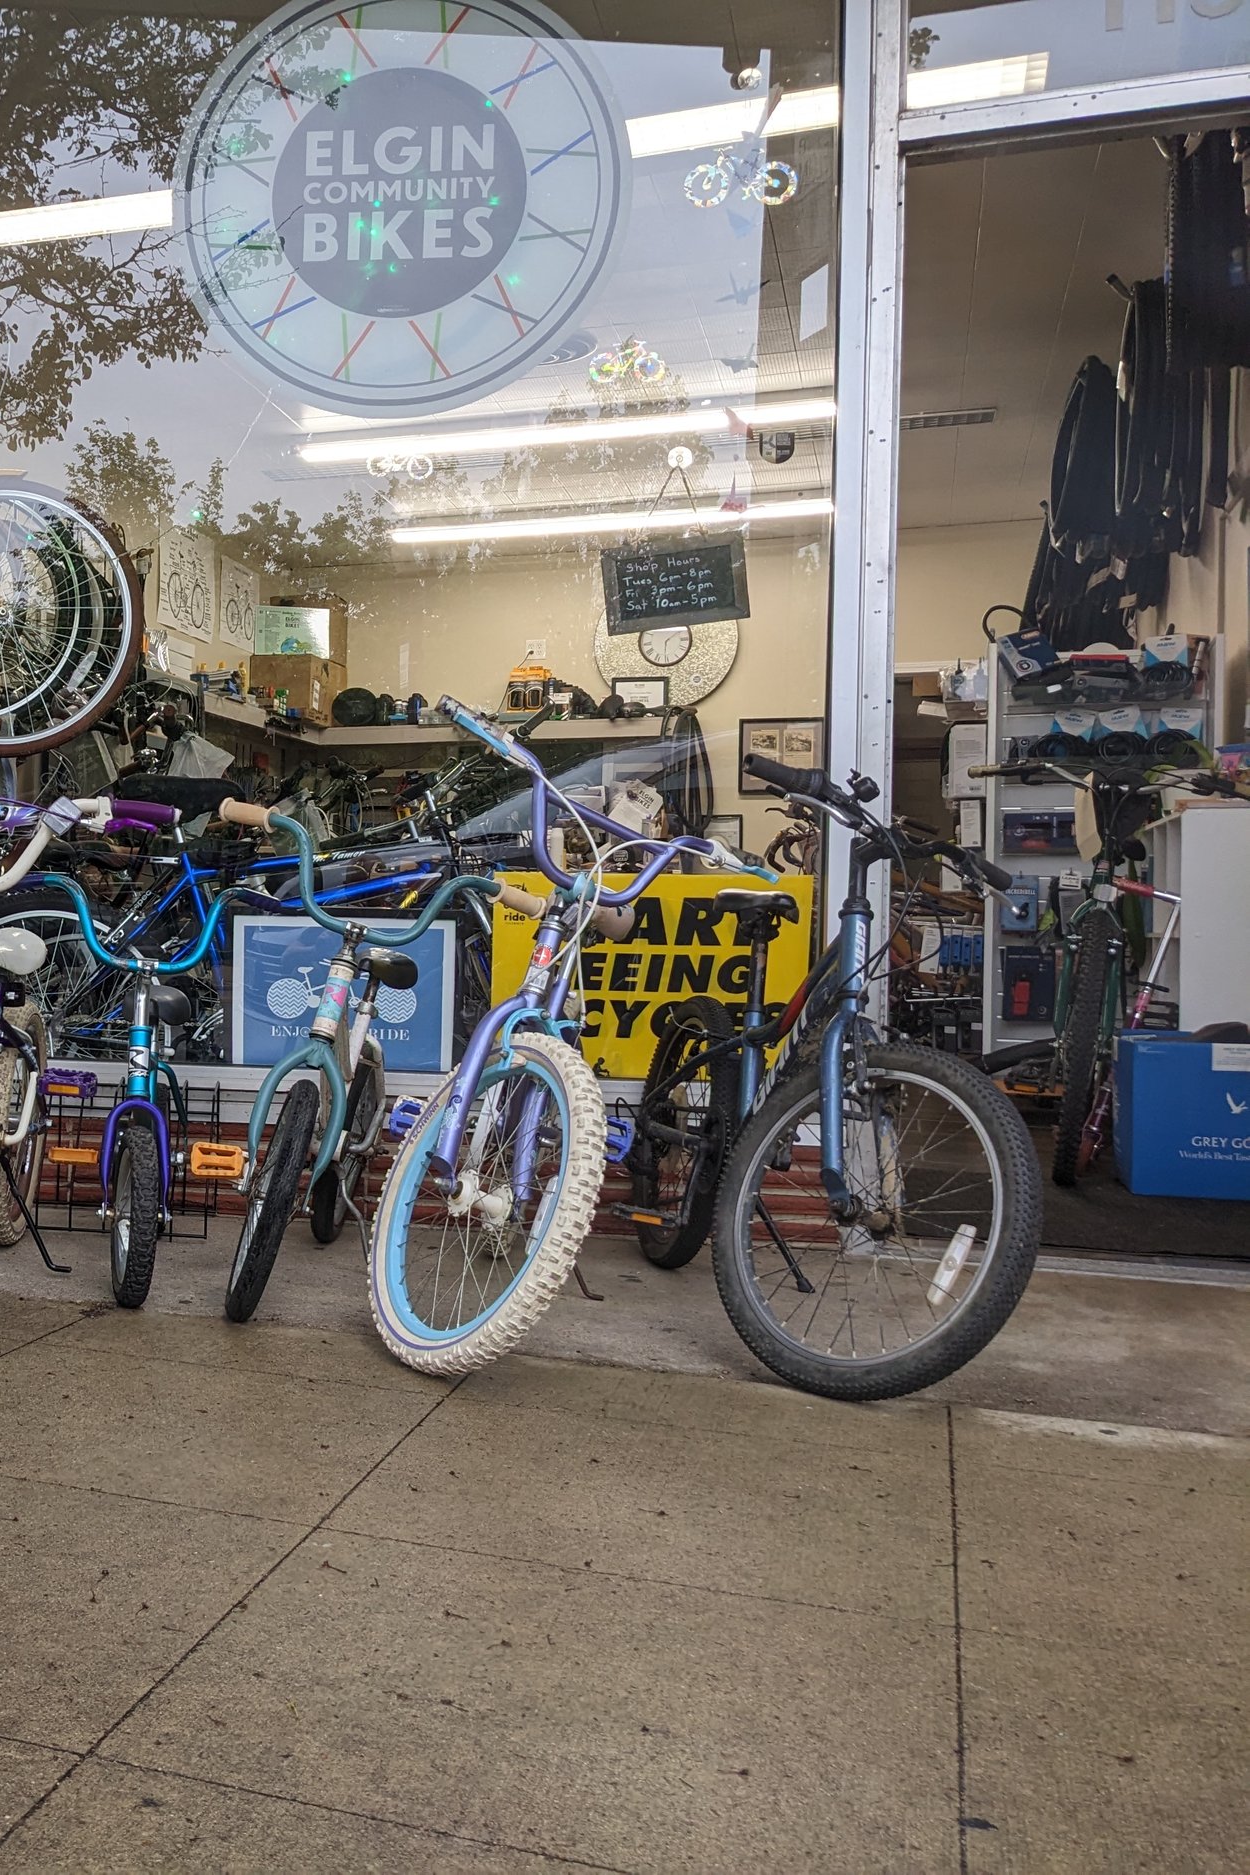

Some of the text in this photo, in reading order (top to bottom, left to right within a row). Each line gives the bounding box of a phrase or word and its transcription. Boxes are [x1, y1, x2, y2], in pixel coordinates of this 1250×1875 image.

[305, 124, 495, 176] ELGIN
[303, 176, 495, 204] COMMUNITY
[303, 207, 494, 262] BIKES
[626, 556, 701, 574] Shop Hours
[623, 576, 652, 587] Tues
[625, 589, 639, 598] Fri
[626, 599, 648, 611] Sat
[504, 912, 526, 921] ride
[573, 952, 752, 994] EEING
[270, 1025, 310, 1038] ENJO
[1191, 1135, 1228, 1148] GREY
